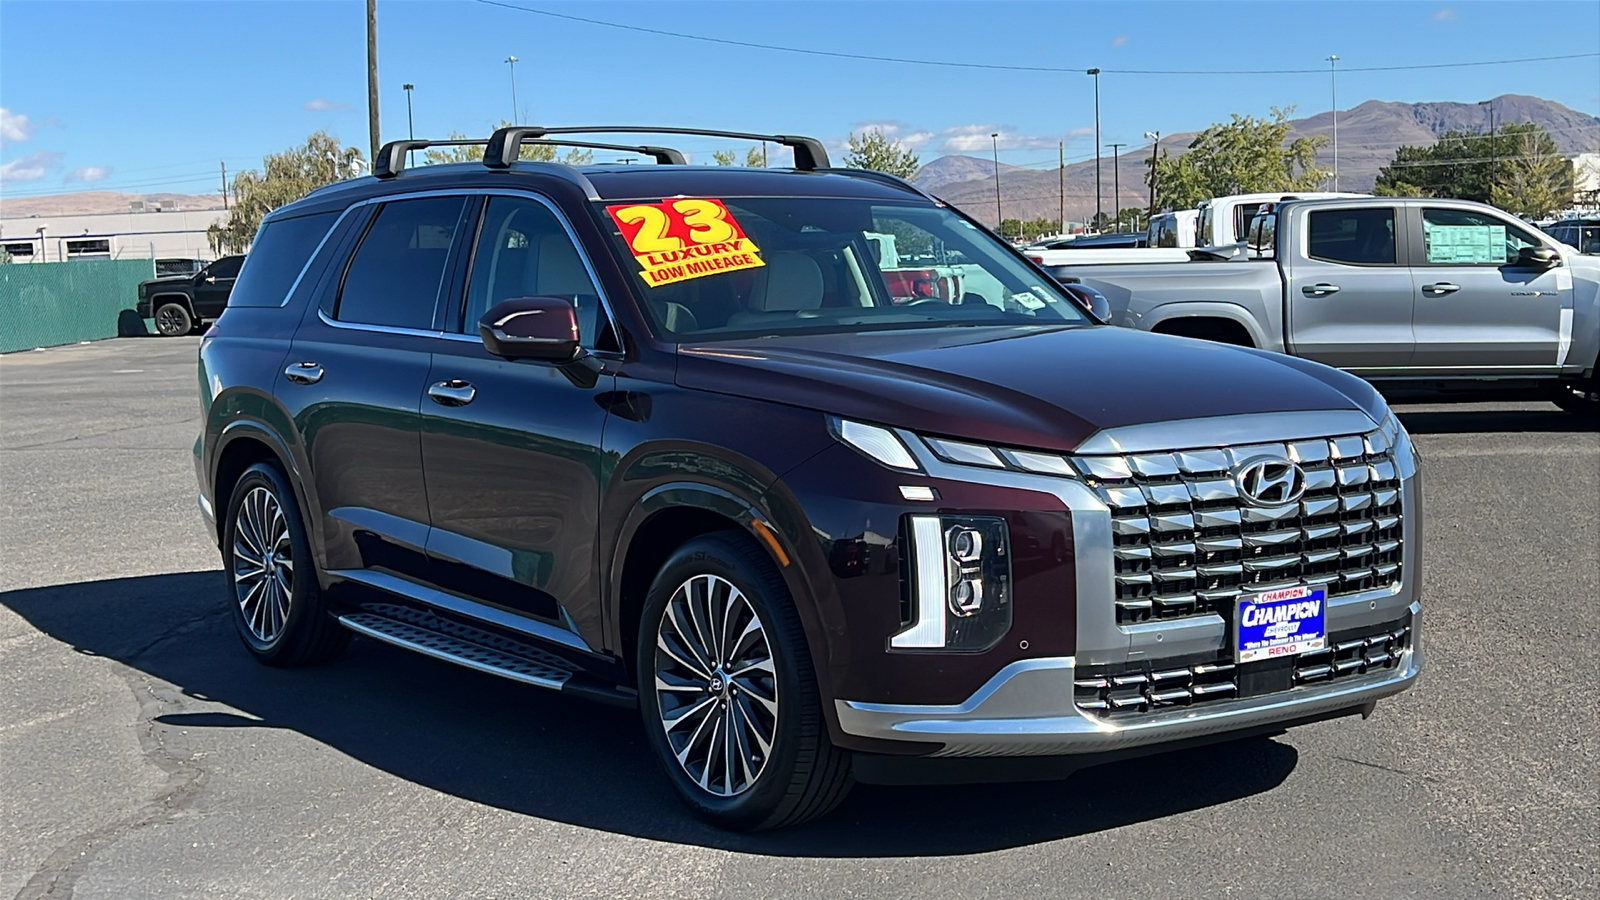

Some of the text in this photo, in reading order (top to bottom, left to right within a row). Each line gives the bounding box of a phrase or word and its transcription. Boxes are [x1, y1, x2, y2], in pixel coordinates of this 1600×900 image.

[615, 199, 738, 253] 23
[647, 240, 744, 266] LUXURY
[649, 253, 755, 283] LOW MILEAGE
[1261, 588, 1303, 602] CHAMPION
[1242, 600, 1321, 627] CHAMPION
[1268, 644, 1297, 656] RENO
